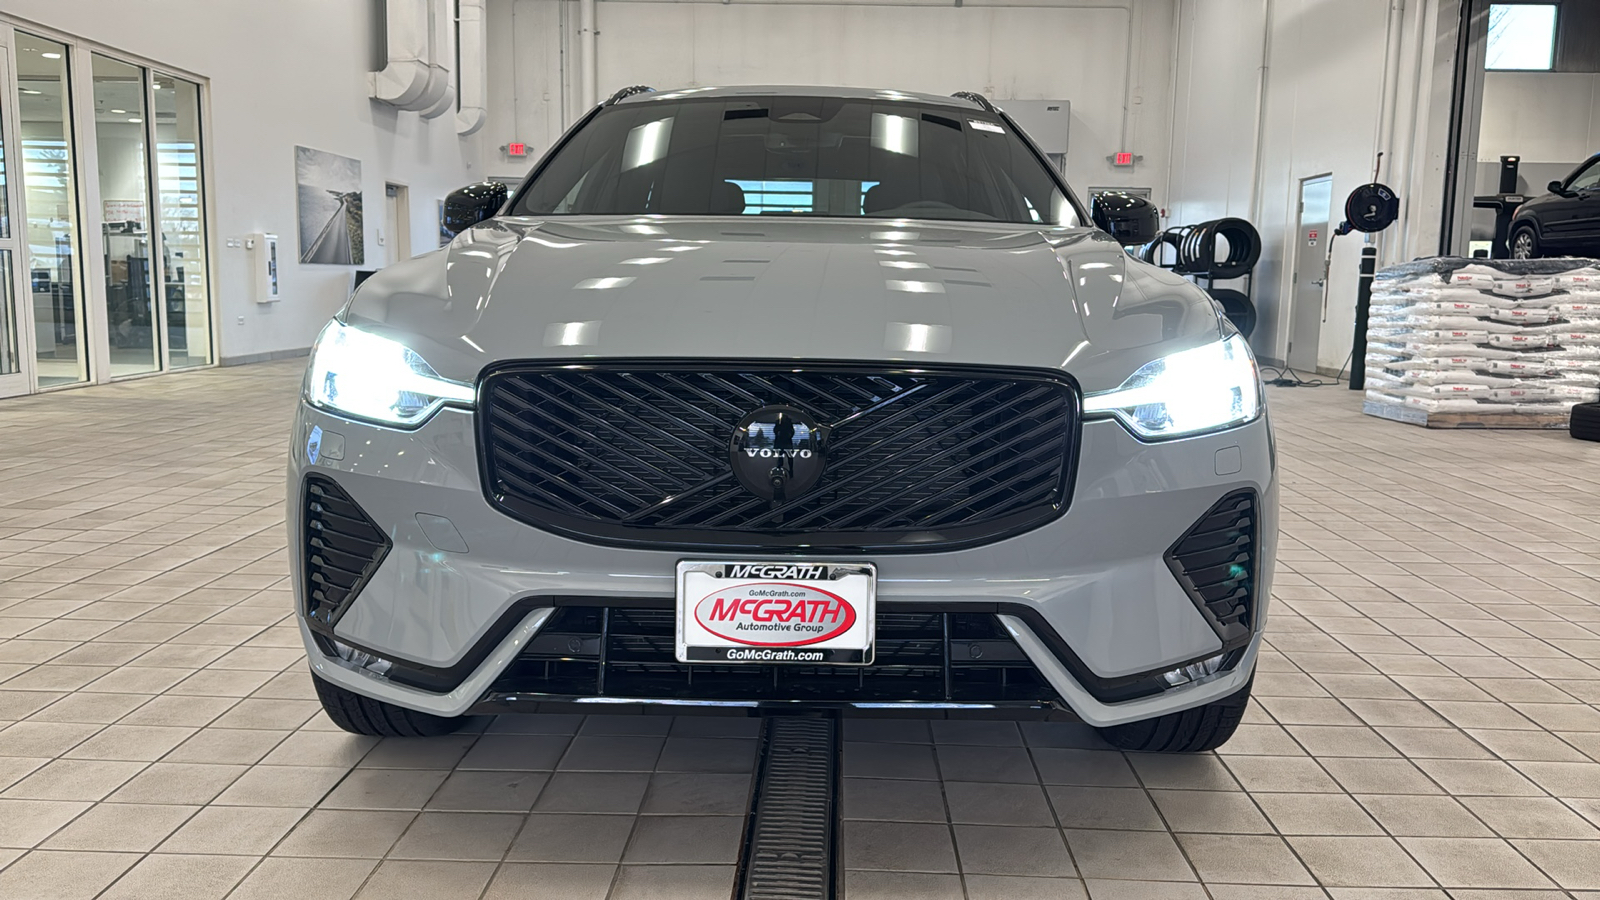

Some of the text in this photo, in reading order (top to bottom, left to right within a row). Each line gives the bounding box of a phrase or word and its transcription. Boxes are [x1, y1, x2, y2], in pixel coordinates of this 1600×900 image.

[510, 143, 524, 155] EXIT
[1117, 152, 1132, 164] EXIT
[744, 448, 812, 458] VOLVO
[748, 589, 806, 598] GoMcGrath.com
[736, 622, 824, 634] Automotive Group
[727, 649, 824, 661] GoMcGrath.com
